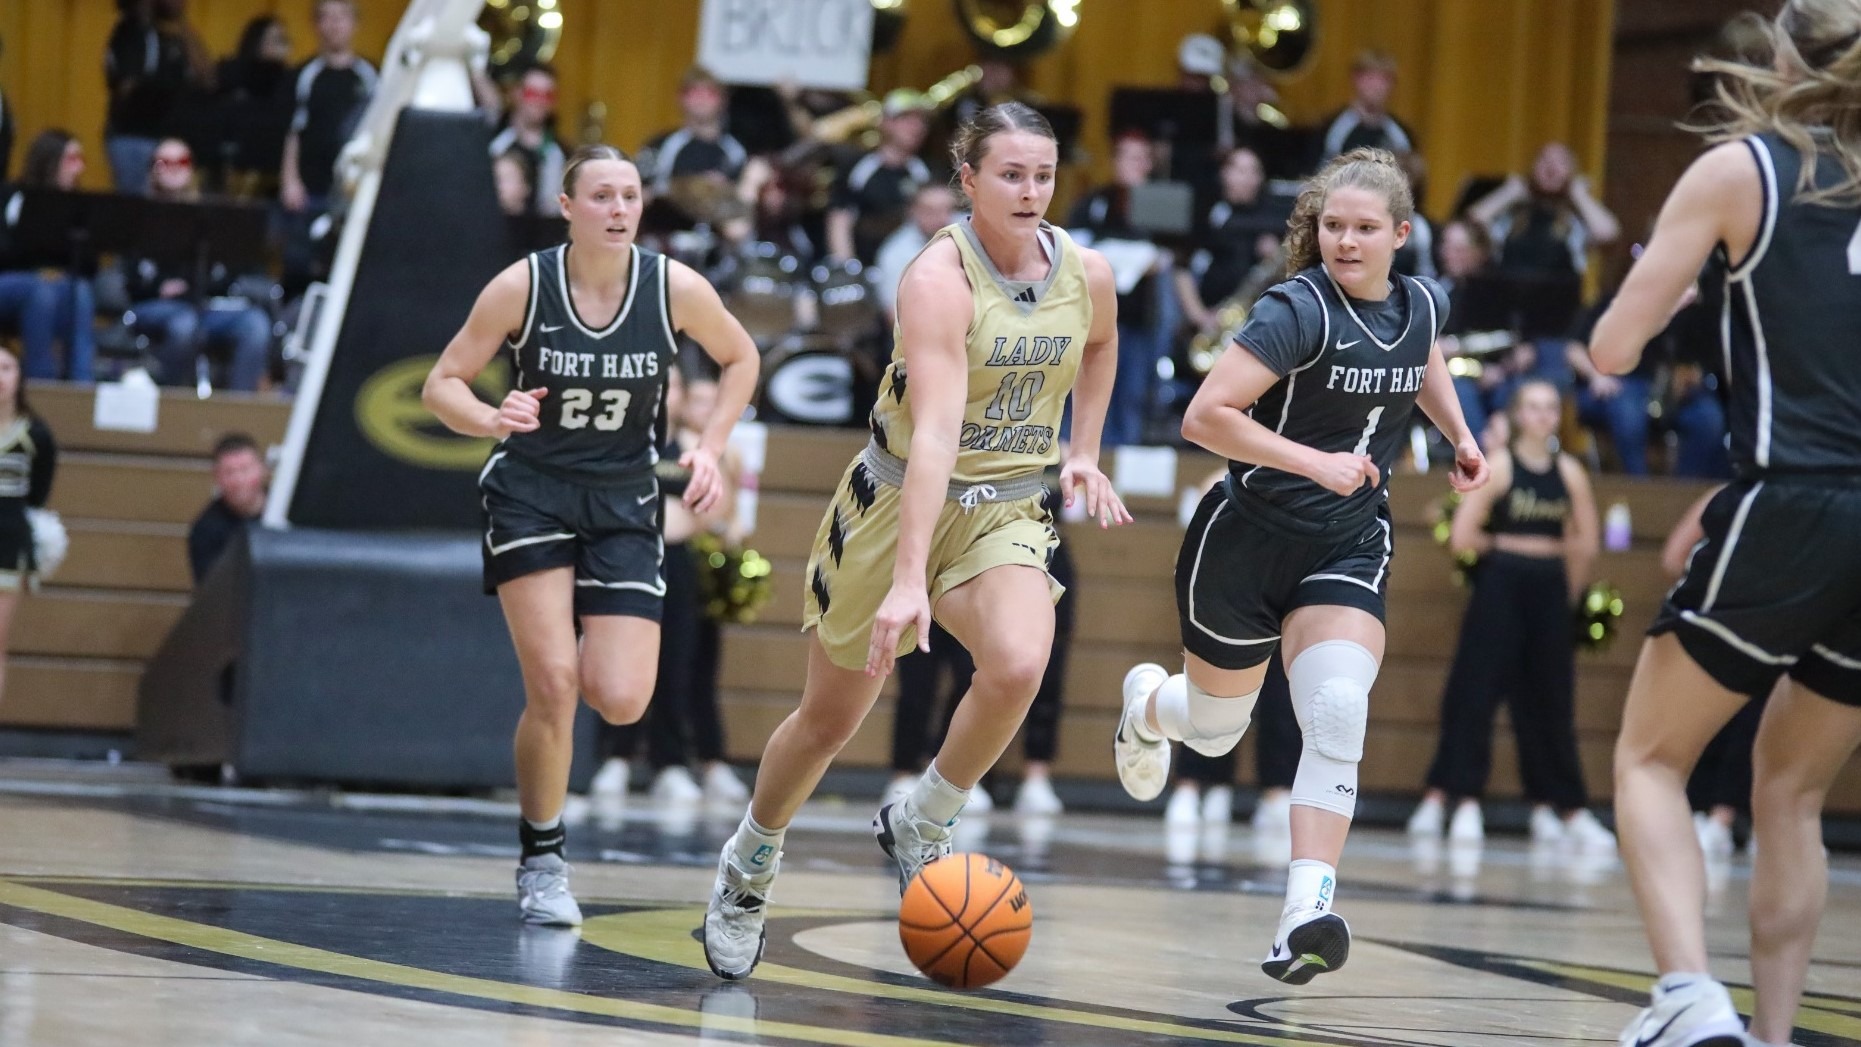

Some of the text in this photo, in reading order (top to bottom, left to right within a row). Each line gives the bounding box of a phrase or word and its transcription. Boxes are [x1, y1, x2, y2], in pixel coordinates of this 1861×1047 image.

[538, 346, 659, 379] FORT HAYS
[985, 336, 1072, 367] LADY
[985, 370, 1045, 421] 10
[1326, 364, 1386, 394] FORT
[560, 388, 632, 431] 23
[959, 421, 1054, 455] ORNETS
[1353, 406, 1386, 457] 1
